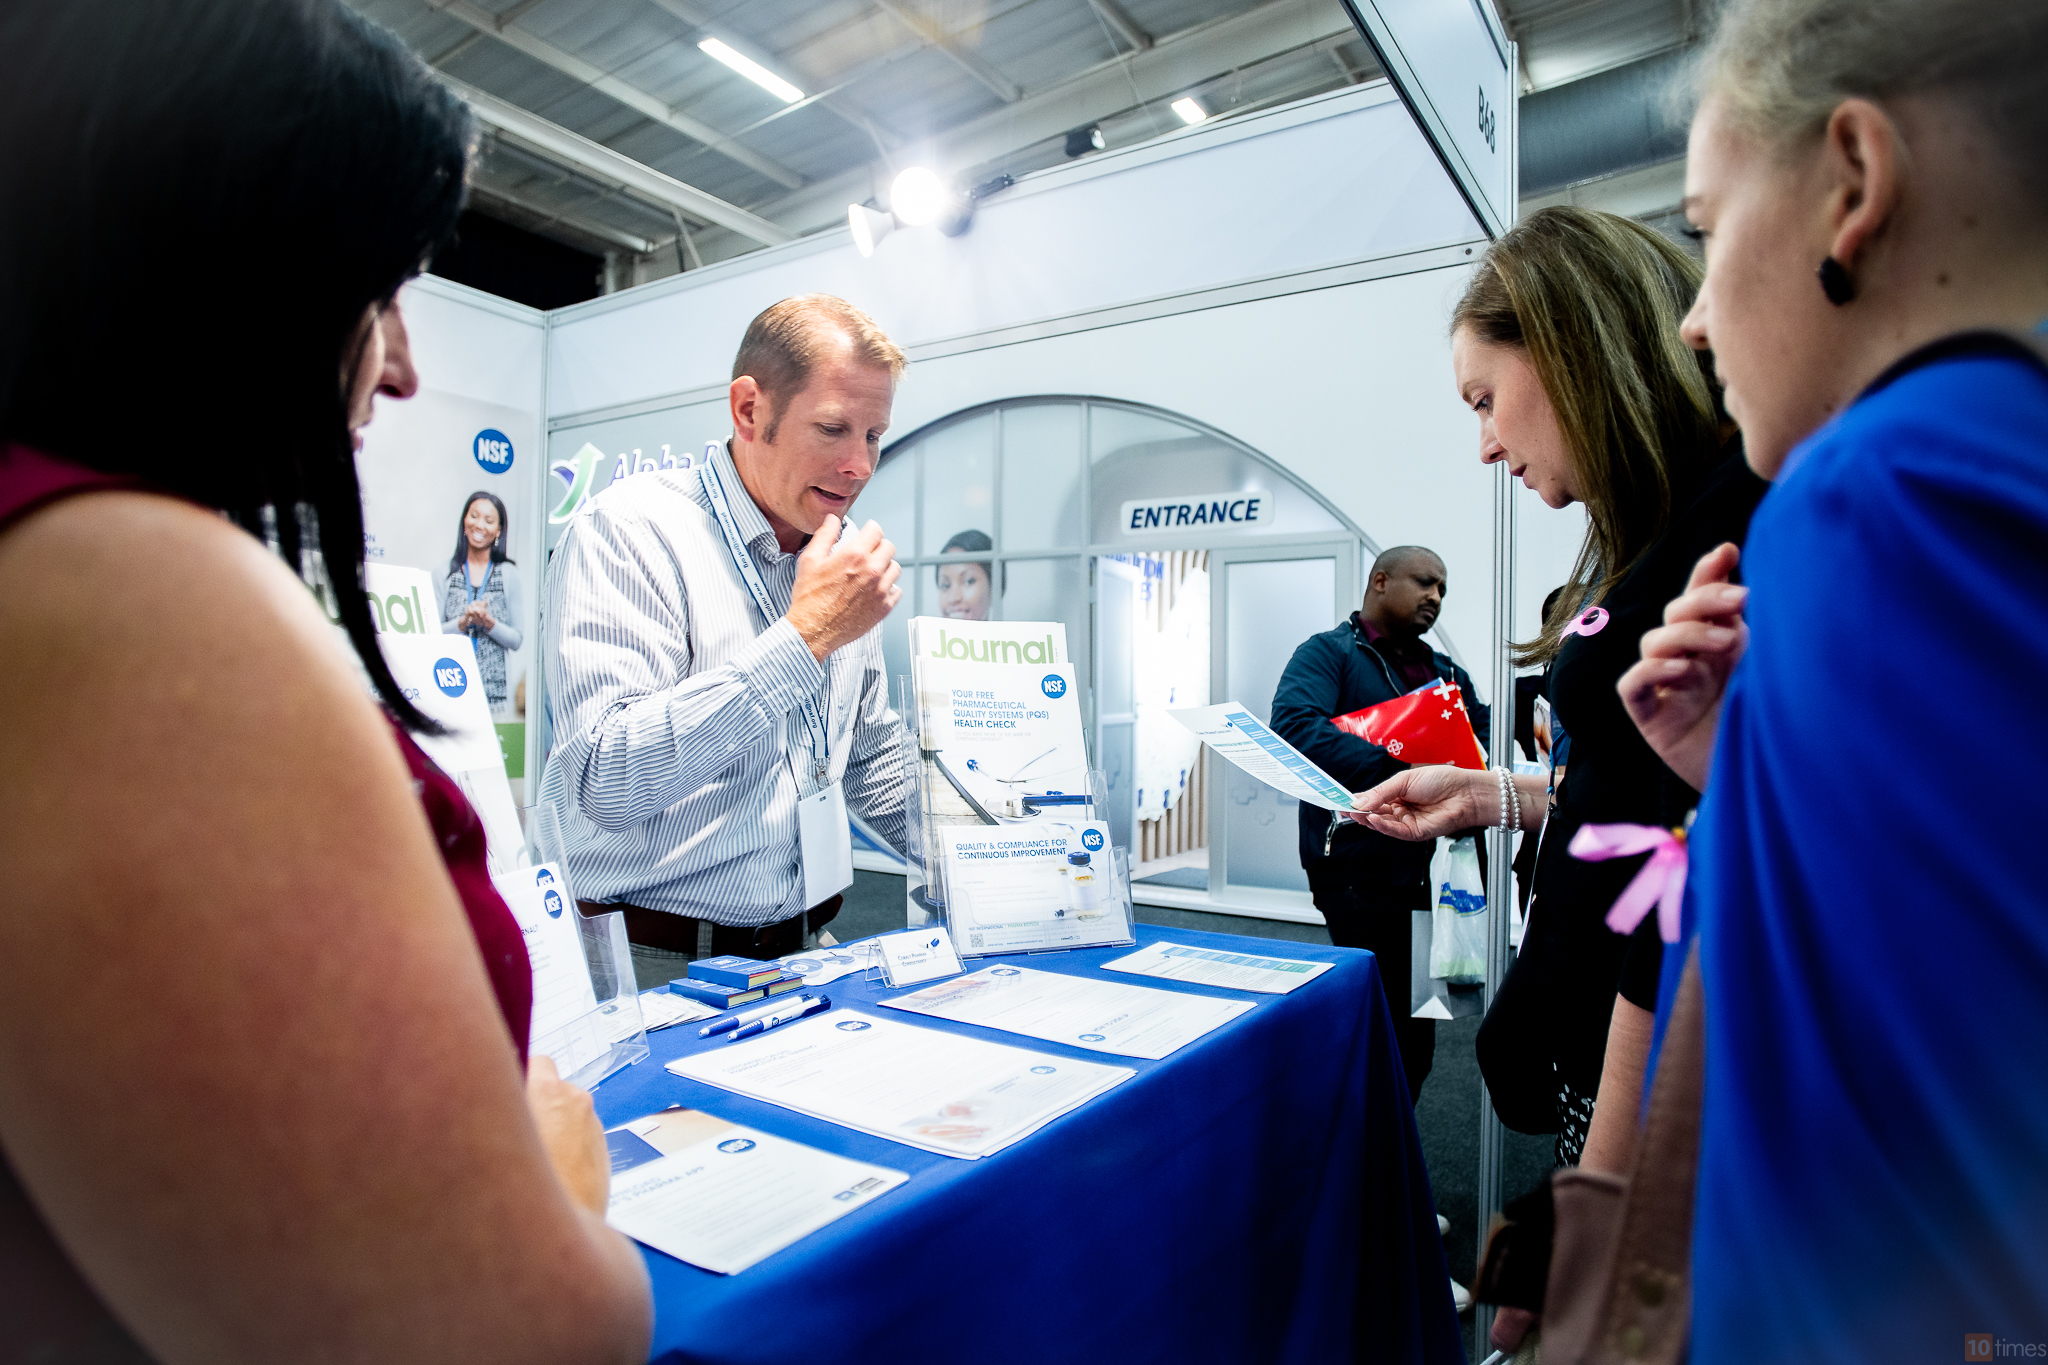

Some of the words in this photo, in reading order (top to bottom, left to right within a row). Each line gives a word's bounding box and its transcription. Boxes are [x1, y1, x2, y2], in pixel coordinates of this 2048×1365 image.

[1478, 84, 1495, 154] B68
[477, 437, 510, 465] NSF
[1130, 498, 1261, 529] ENTRANCE
[753, 582, 777, 623] www.nsfpharm
[931, 629, 1055, 664] Journal
[435, 667, 465, 688] NSF
[1043, 679, 1064, 693] NSF
[400, 688, 421, 701] OR
[951, 689, 974, 699] YOUR
[975, 690, 995, 700] FREE
[952, 699, 1027, 710] PHARMACEUTICAL
[953, 708, 986, 719] QUALITY
[988, 710, 1024, 719] SYSTEMS
[1026, 710, 1050, 720] (PQS)
[954, 719, 984, 728] HEALTH
[985, 720, 1017, 729] CHECK
[955, 841, 987, 851] QUALITY
[989, 841, 995, 850] &
[997, 839, 1049, 850] COMPLIANCE
[1051, 838, 1068, 847] FOR
[1083, 833, 1102, 846] NSF
[957, 850, 1009, 860] CONTINUOUS
[1010, 847, 1067, 858] IMPROVEMENT
[545, 898, 562, 914] NSF
